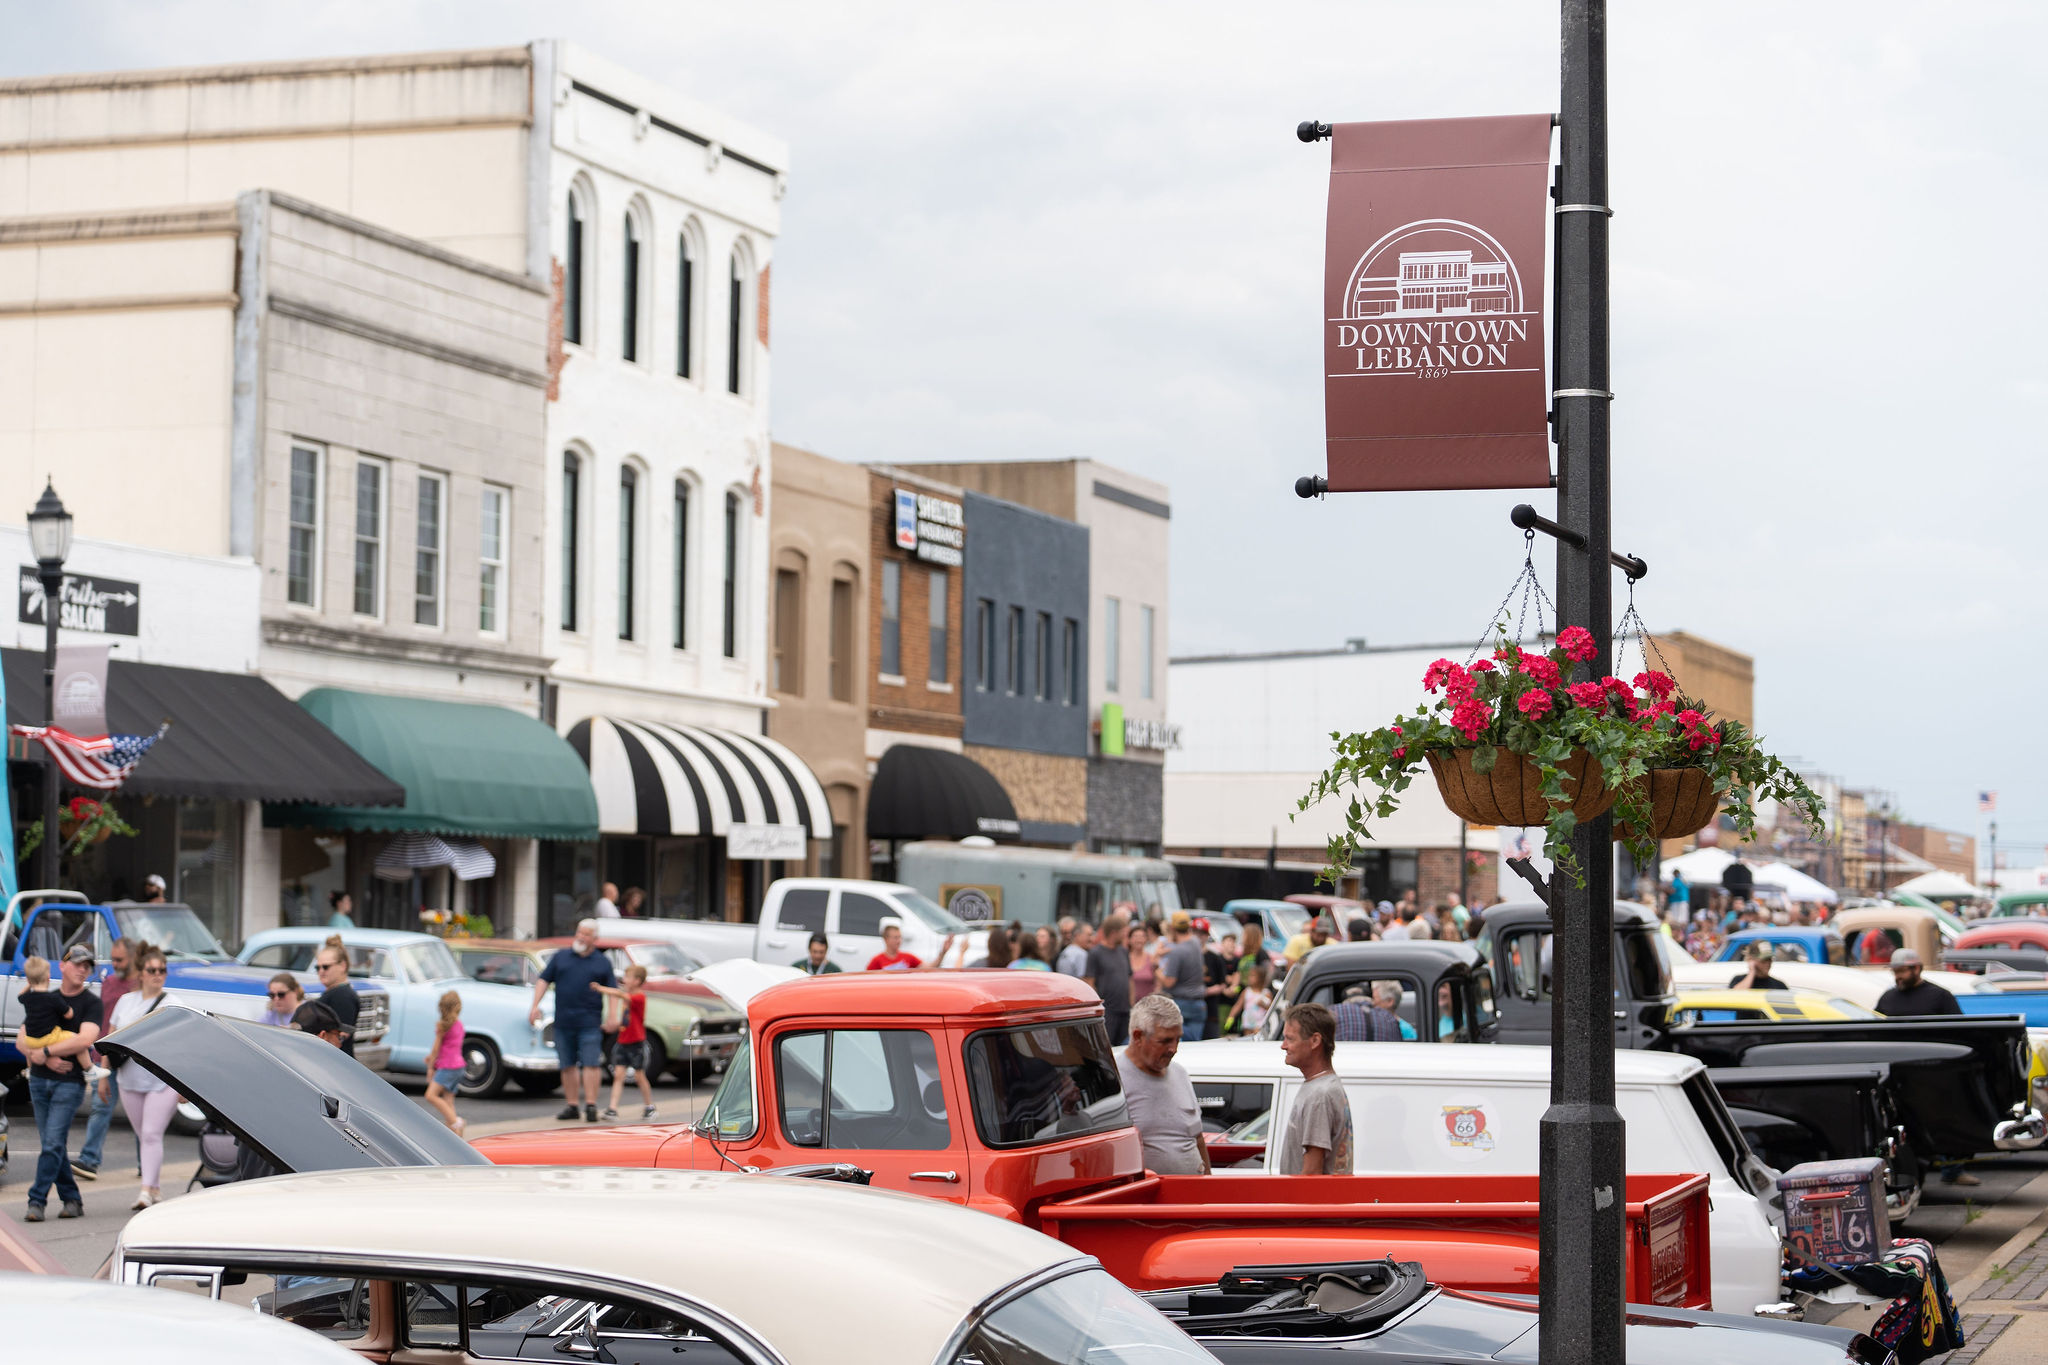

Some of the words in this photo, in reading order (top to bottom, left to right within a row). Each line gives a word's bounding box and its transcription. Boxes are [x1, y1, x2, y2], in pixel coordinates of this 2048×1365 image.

[1337, 319, 1528, 348] DOWNTOWN
[1356, 343, 1508, 370] LEBANON
[1417, 367, 1449, 379] 1869
[60, 602, 106, 632] SALON
[1457, 1122, 1473, 1133] 66
